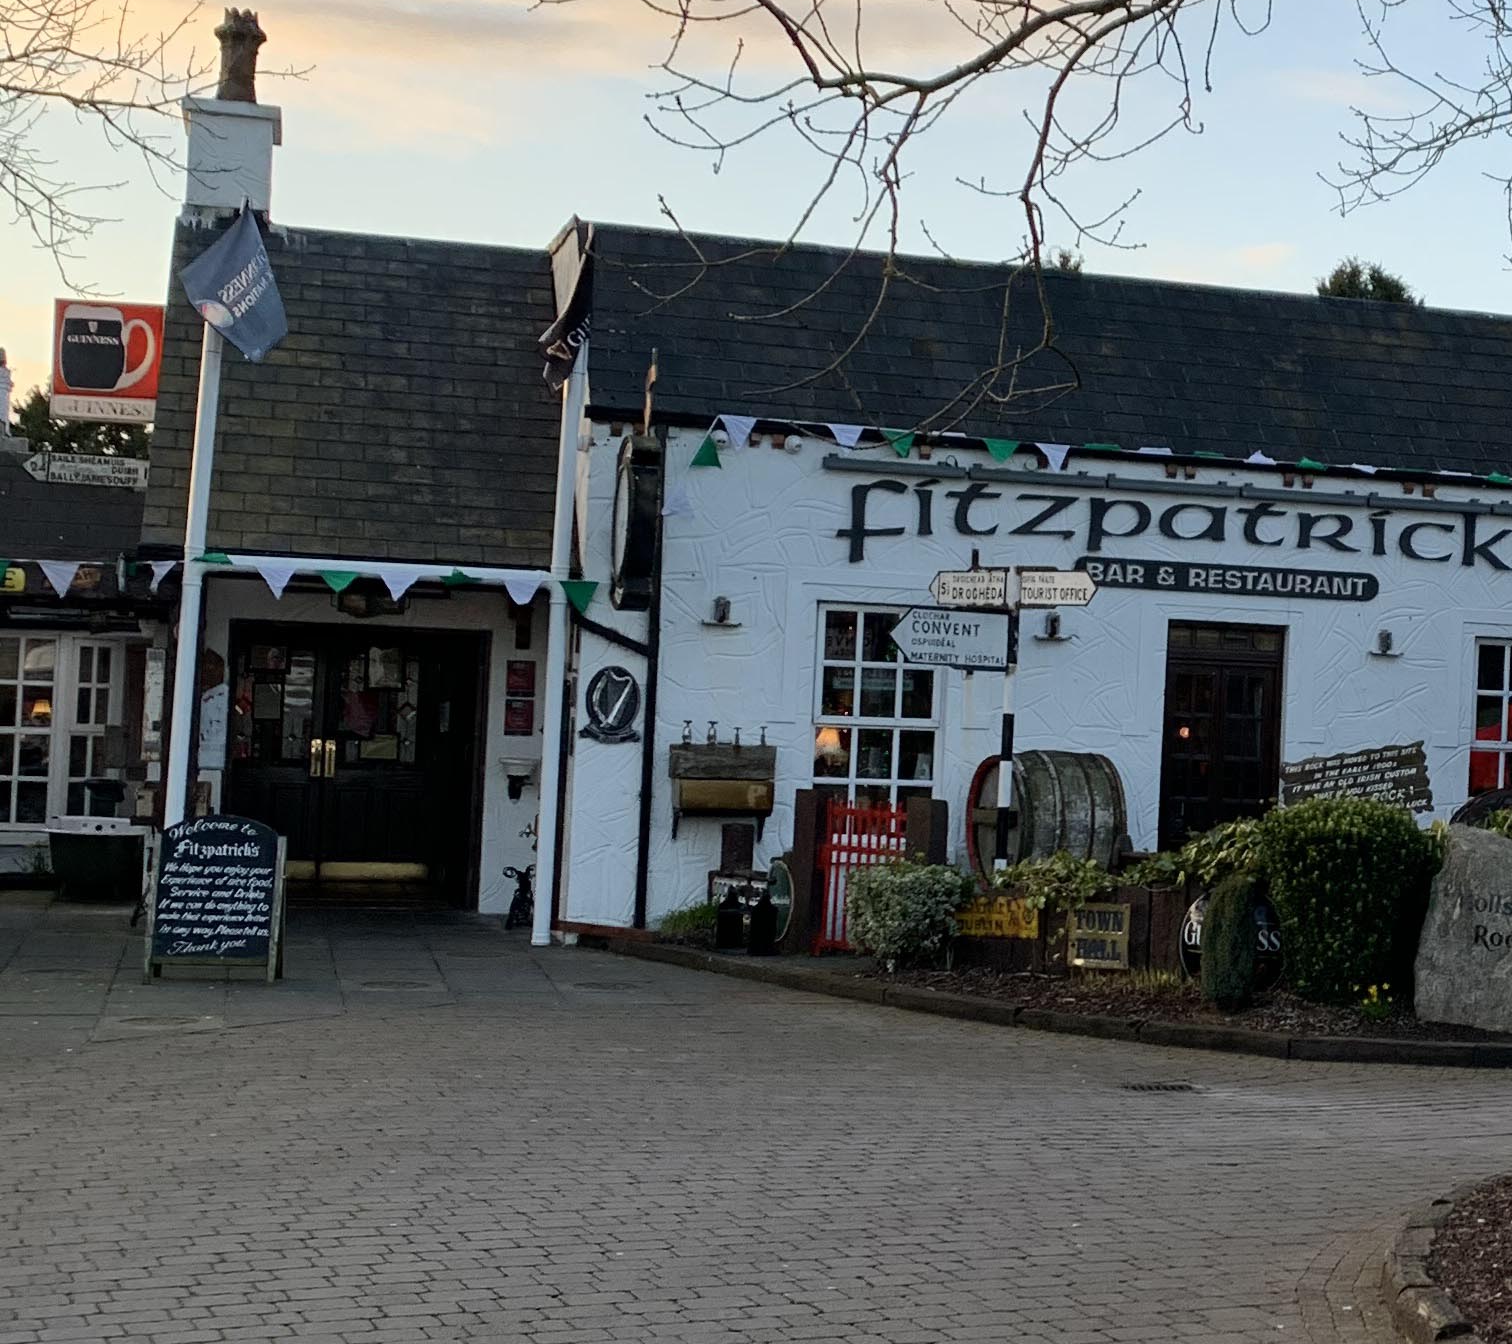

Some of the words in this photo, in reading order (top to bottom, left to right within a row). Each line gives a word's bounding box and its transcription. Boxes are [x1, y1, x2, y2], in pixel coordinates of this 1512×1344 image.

[67, 334, 119, 345] GUINNESS
[1087, 561, 1144, 585] BAR
[1157, 566, 1176, 587] &
[1188, 568, 1369, 597] RESTAURANT
[952, 586, 1004, 601] DROGHEDA
[1022, 587, 1057, 601] TOURIST
[1059, 587, 1088, 602] OFFICE
[911, 620, 981, 637] CONVENT
[910, 651, 960, 663] MATERNITY
[964, 655, 1005, 666] HOSPITAL
[1285, 764, 1302, 774] THIS
[1304, 761, 1324, 772] ROCK
[1370, 752, 1381, 761] TO
[1382, 749, 1399, 759] THIS
[1313, 771, 1323, 779] IN
[1325, 768, 1339, 778] THE
[1341, 764, 1370, 775] EARLY
[1292, 785, 1303, 793] IT
[1304, 782, 1322, 792] WAS
[1323, 779, 1336, 788] AN
[1338, 776, 1354, 787] OLD
[1356, 772, 1382, 783] IRISH
[1384, 767, 1417, 779] CUSTOM
[1346, 786, 1365, 797] YOU
[1366, 782, 1394, 793] KISSED
[1406, 798, 1428, 809] LUCK
[169, 818, 239, 841] Welcome
[240, 823, 259, 836] to
[173, 839, 260, 860] Fitzpatrick's
[164, 862, 179, 872] We
[203, 865, 223, 875] you
[223, 864, 250, 877] enjoy
[249, 867, 273, 877] your
[160, 874, 213, 886] Experience
[215, 875, 229, 885] of
[226, 877, 247, 887] nice
[170, 886, 210, 898] Service
[211, 888, 235, 898] and
[234, 887, 266, 900] Drinks
[158, 898, 172, 909] If
[170, 902, 185, 910] we
[186, 902, 203, 910] can
[204, 899, 217, 910] do
[216, 901, 257, 913] anything
[257, 902, 270, 912] to
[157, 911, 181, 920] make
[181, 912, 201, 921] that
[201, 913, 245, 923] experience
[1076, 911, 1123, 932] TOWN
[172, 927, 192, 937] any
[214, 924, 244, 935] Please
[243, 926, 259, 936] tell
[166, 939, 219, 955] Thank
